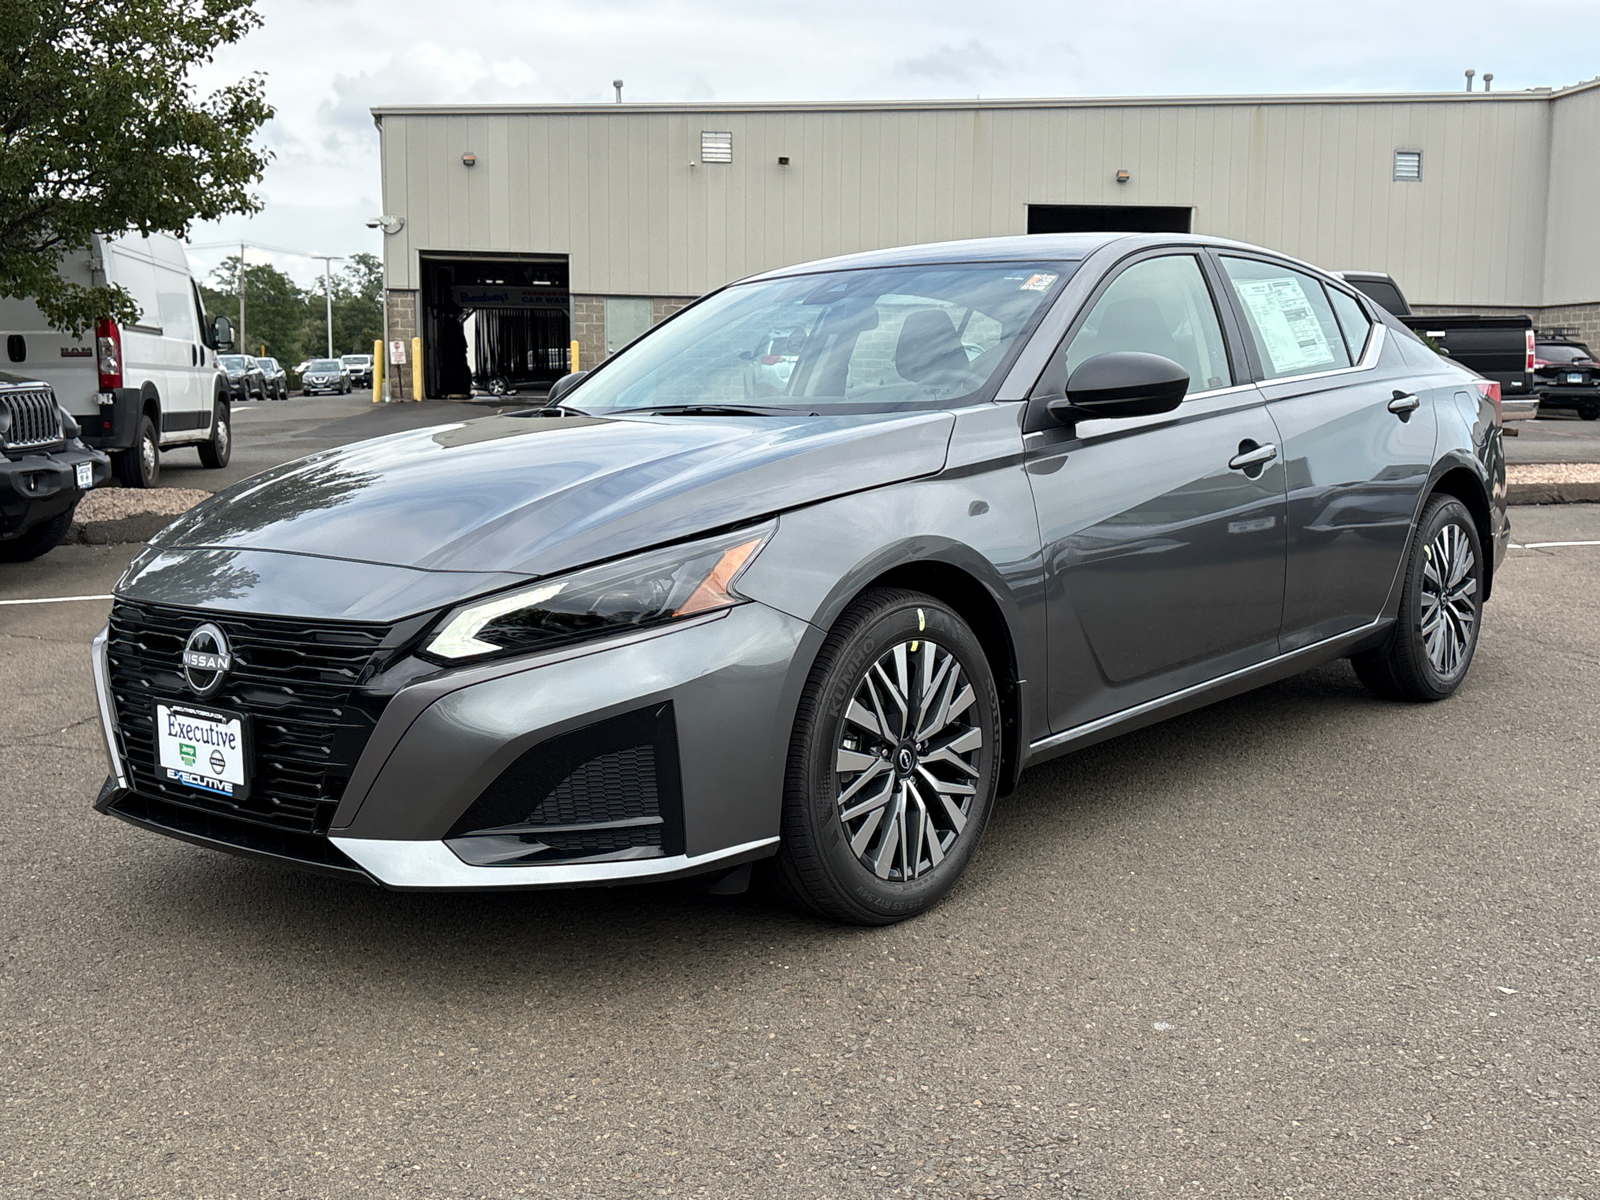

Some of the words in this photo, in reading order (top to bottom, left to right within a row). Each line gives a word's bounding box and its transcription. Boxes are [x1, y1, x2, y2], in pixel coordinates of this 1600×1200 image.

[60, 346, 93, 357] RAM
[183, 652, 228, 669] NISSAN
[829, 638, 875, 718] KUMHO
[986, 677, 1000, 756] SOLUS
[167, 713, 236, 750] Executive
[181, 745, 194, 755] Jeep
[167, 769, 233, 793] EXECUTIVE
[873, 898, 892, 909] R17
